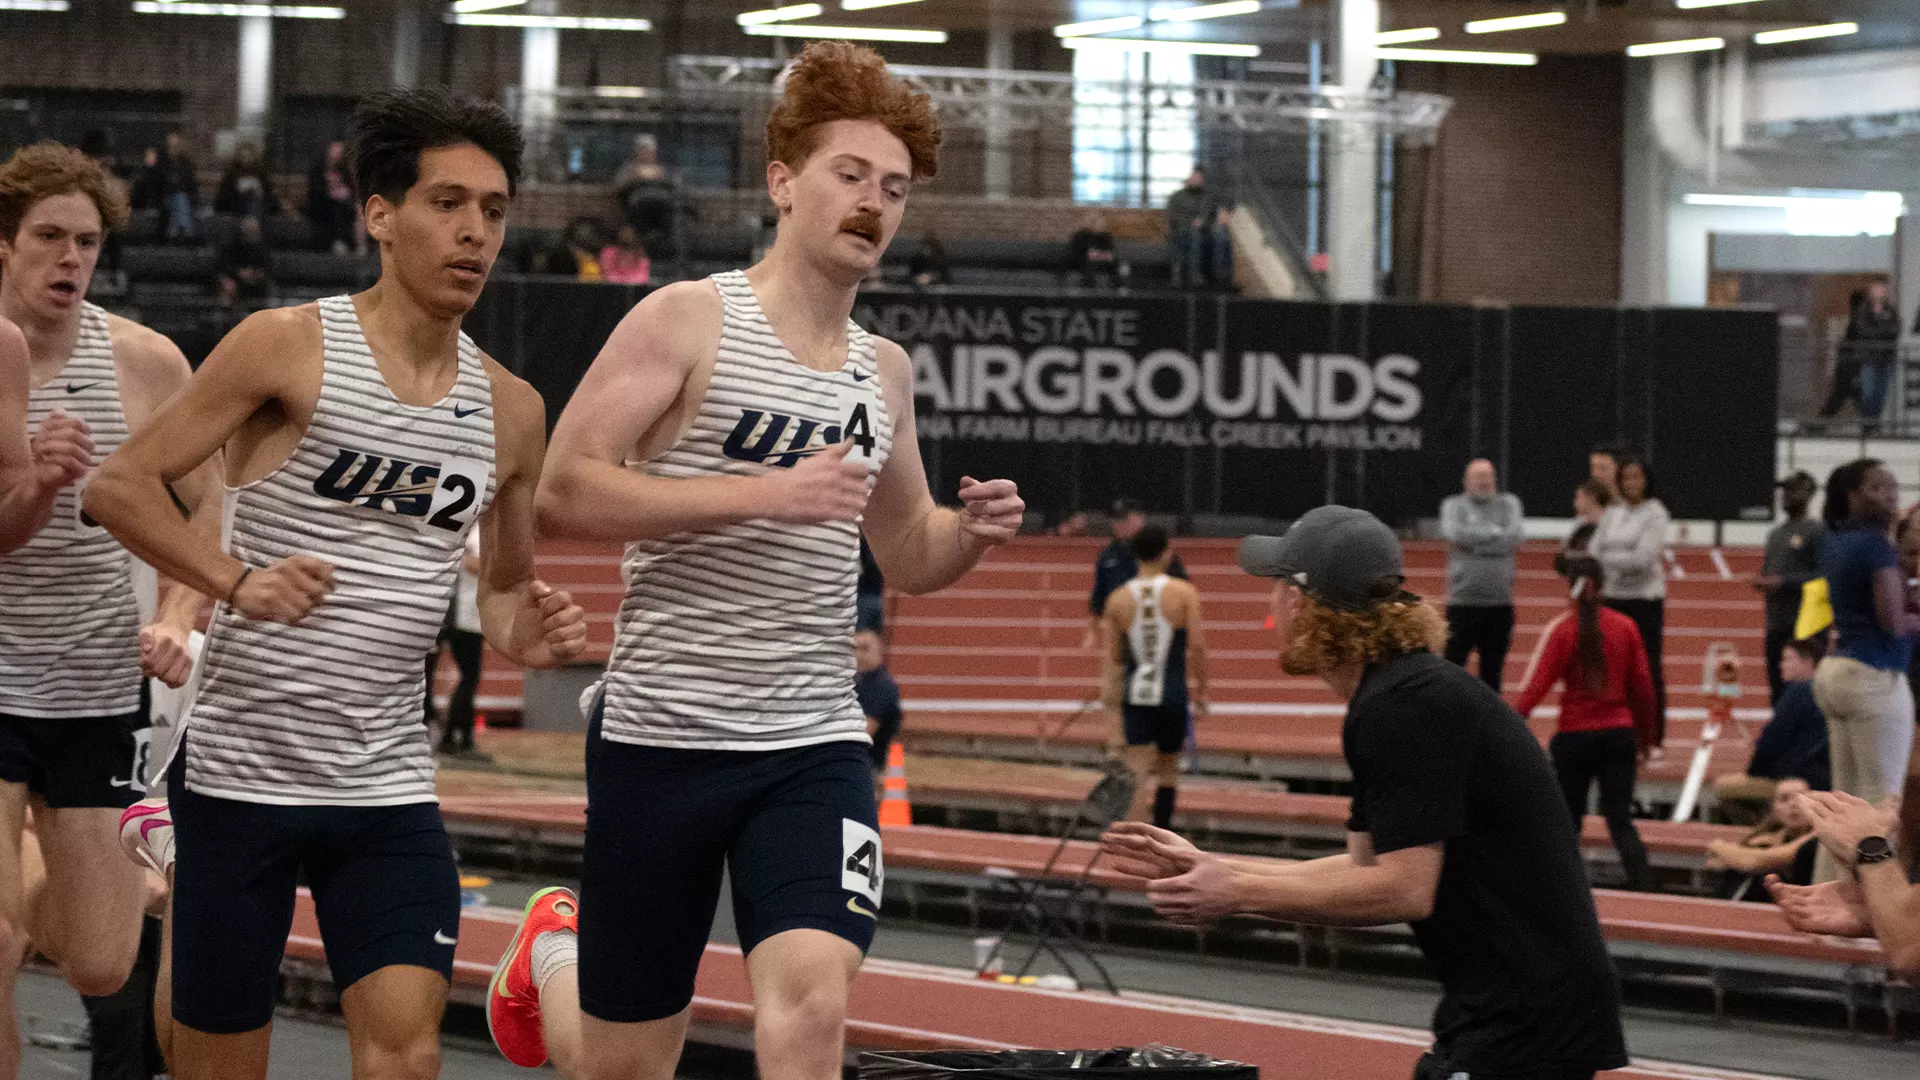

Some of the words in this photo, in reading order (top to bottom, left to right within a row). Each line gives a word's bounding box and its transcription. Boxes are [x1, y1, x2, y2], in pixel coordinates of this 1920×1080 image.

[855, 303, 1013, 341] NDIANA
[1020, 306, 1140, 346] STATE
[911, 343, 1422, 422] AIRGROUNDS
[843, 402, 876, 458] 4
[957, 416, 1030, 441] FARM
[1033, 416, 1142, 445] BUREAU
[1147, 420, 1206, 447] FALL
[1210, 419, 1301, 449] CREEK
[1306, 423, 1421, 450] PAVILION
[427, 474, 476, 532] 2
[846, 839, 879, 892] 4
